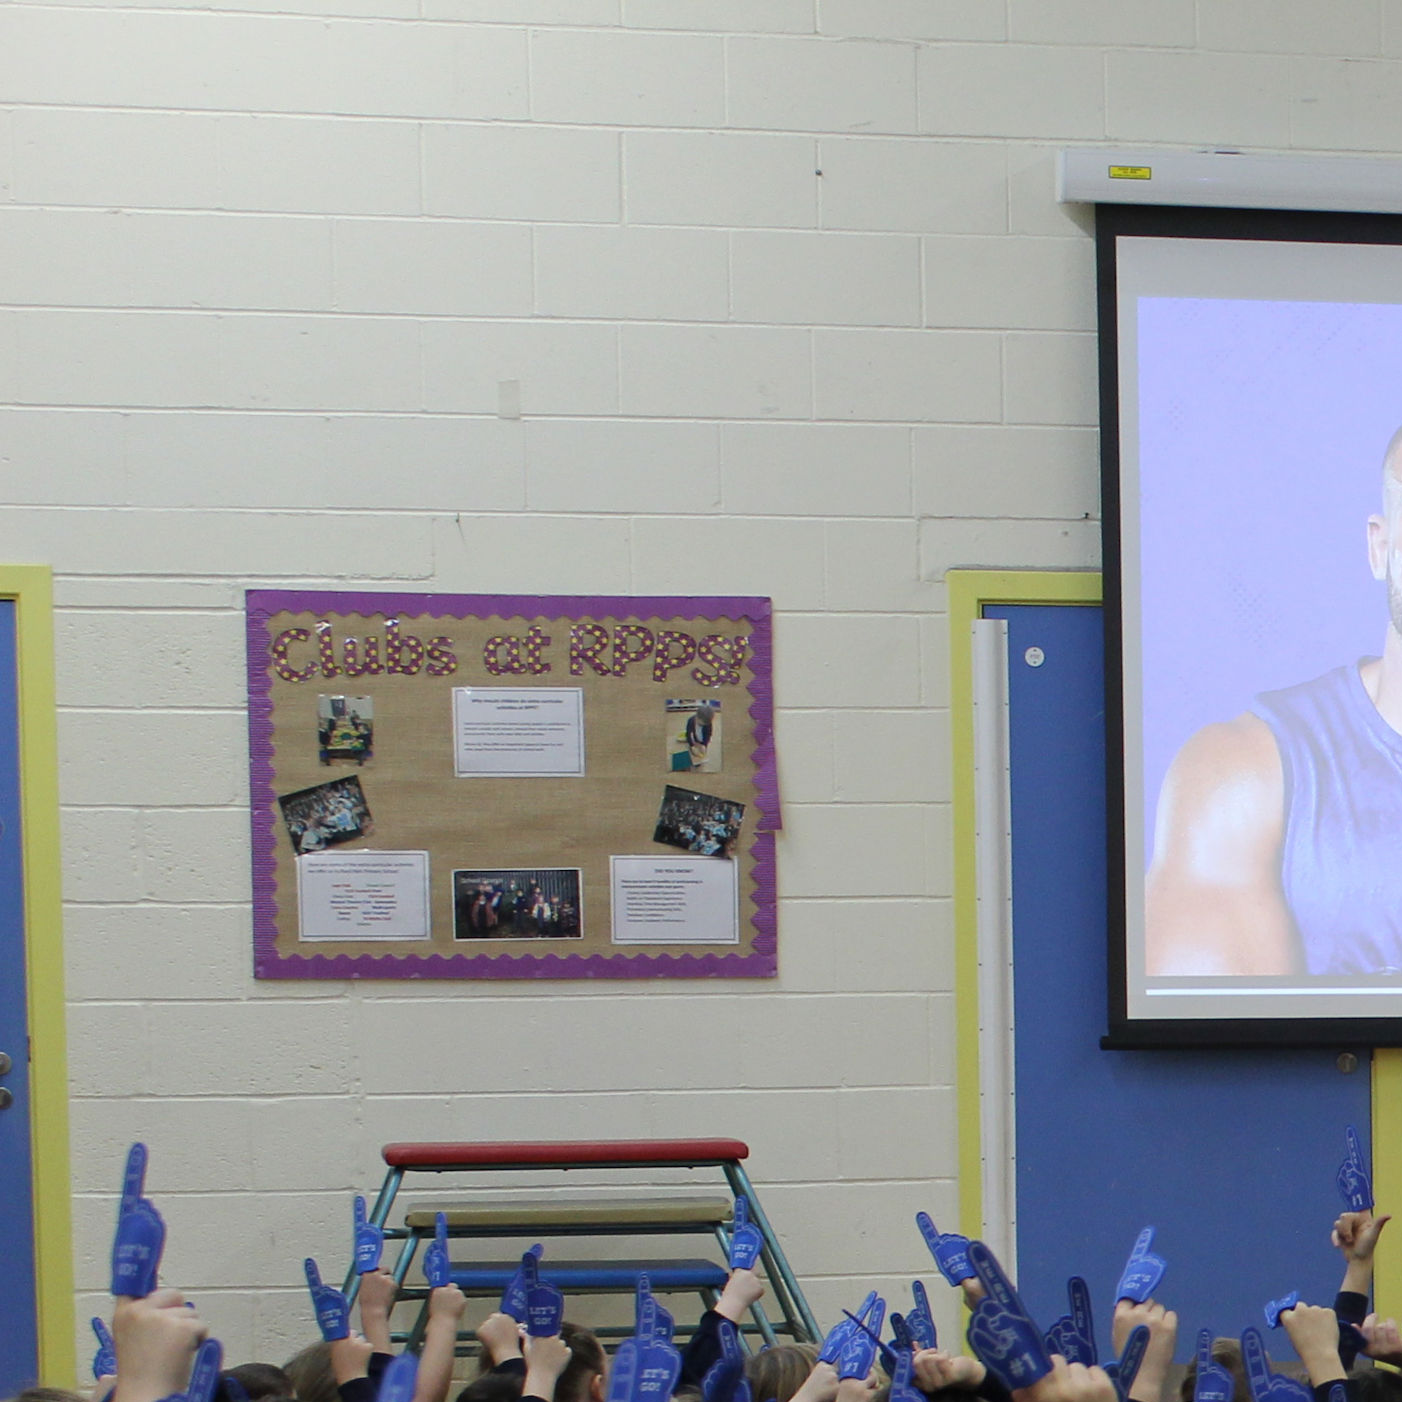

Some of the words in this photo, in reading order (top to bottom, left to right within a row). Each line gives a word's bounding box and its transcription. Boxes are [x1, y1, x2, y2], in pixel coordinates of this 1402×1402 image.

[272, 620, 458, 682] Clubs
[485, 626, 551, 676] at
[570, 624, 751, 687] RPPS!
[1009, 1353, 1037, 1377] #1
